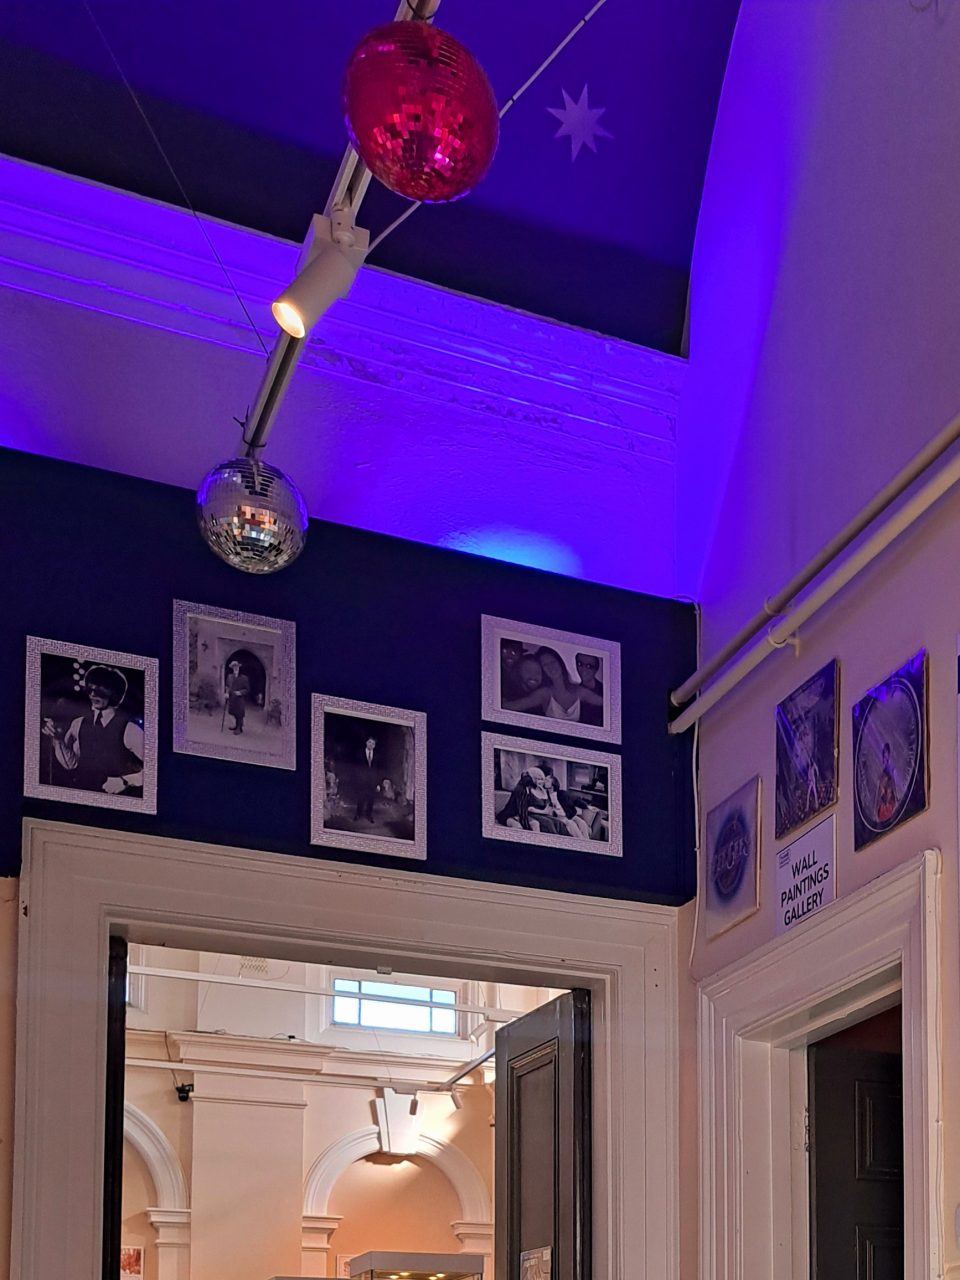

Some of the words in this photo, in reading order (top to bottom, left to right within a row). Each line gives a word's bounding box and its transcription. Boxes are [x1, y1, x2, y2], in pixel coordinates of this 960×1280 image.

[792, 850, 818, 880] WALL
[781, 863, 830, 908] PAINTINGS
[784, 888, 824, 926] GALLERY
